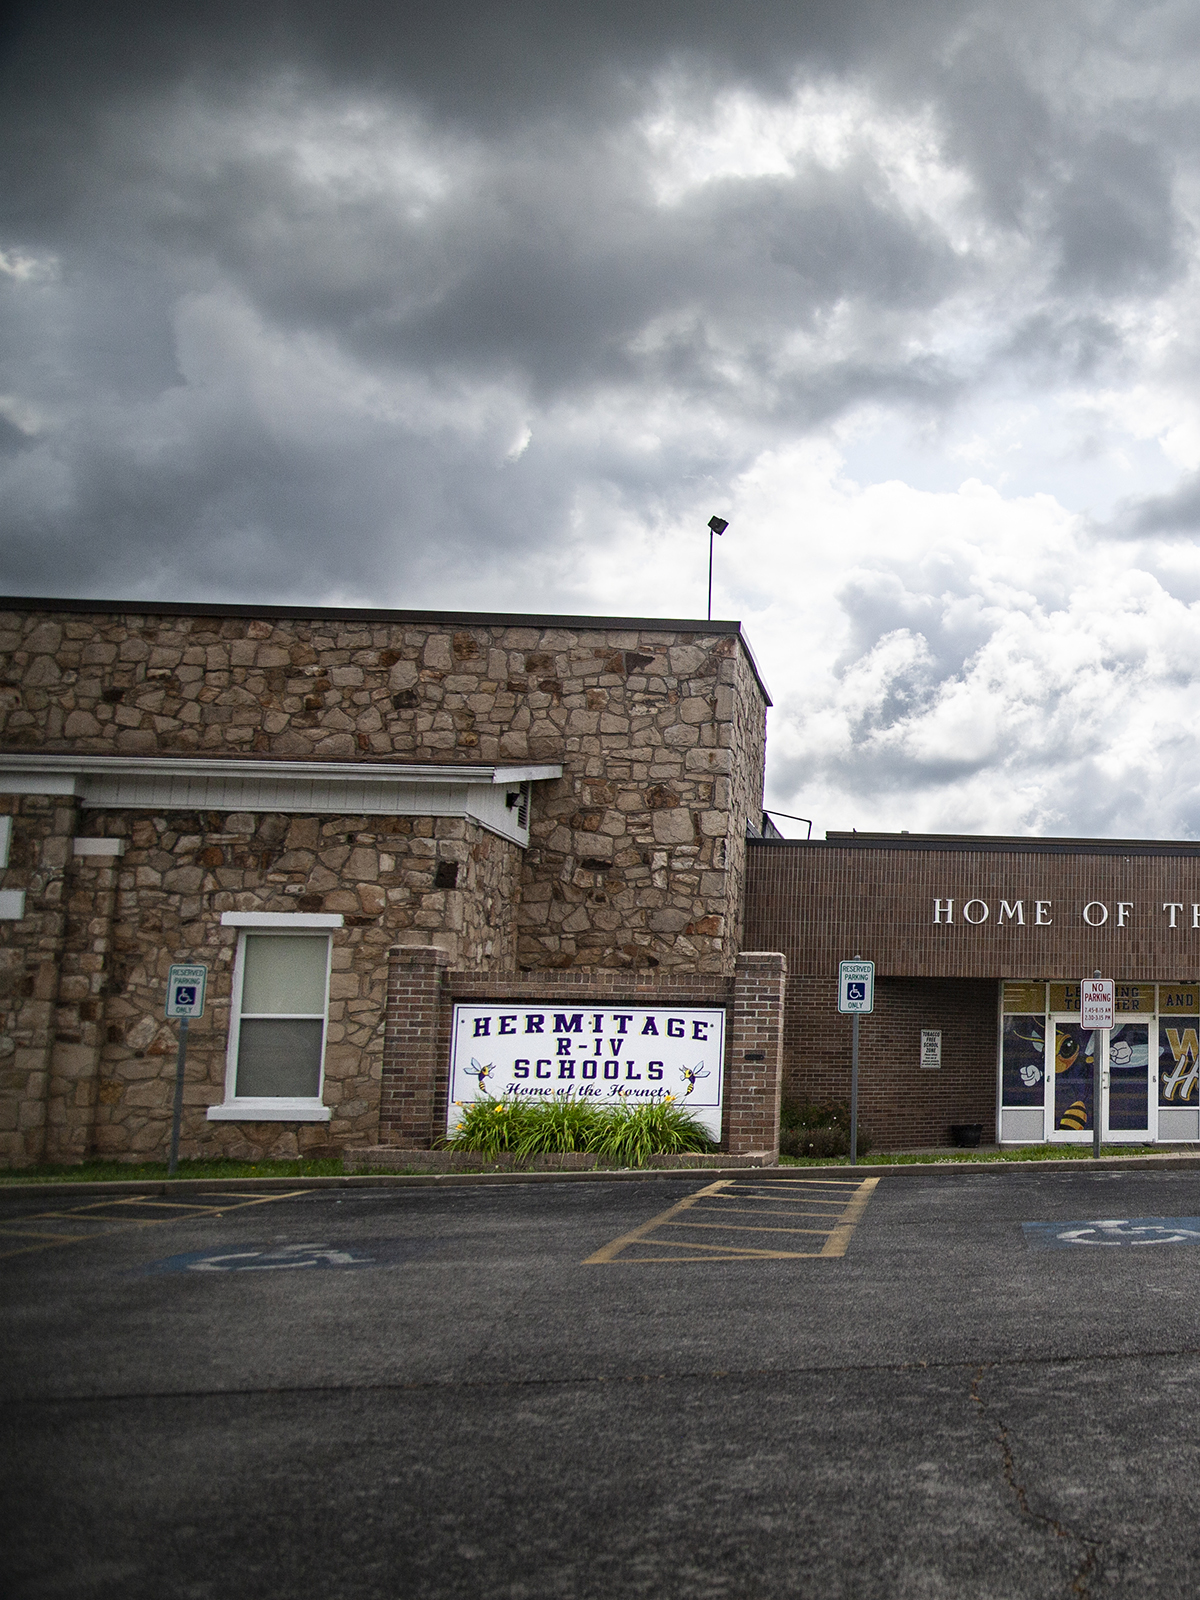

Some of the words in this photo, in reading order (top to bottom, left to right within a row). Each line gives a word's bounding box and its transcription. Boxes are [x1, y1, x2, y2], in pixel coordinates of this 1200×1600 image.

[932, 898, 1053, 926] HOME
[1082, 901, 1134, 928] OF
[172, 969, 205, 977] RESERVED
[842, 965, 871, 973] RESERVED
[173, 977, 201, 985] PARKING
[1065, 986, 1139, 998] LEING
[1091, 983, 1104, 992] NO
[1084, 993, 1111, 1002] PARKING
[1166, 994, 1194, 1007] AND
[1064, 999, 1139, 1010] TOHER
[473, 1013, 709, 1042] HERMITAGE
[556, 1037, 625, 1057] R-IV
[513, 1059, 665, 1080] SCHOOLS
[503, 1082, 551, 1096] Home
[556, 1084, 575, 1096] of
[578, 1083, 602, 1096] the
[607, 1084, 671, 1097] Hornets
